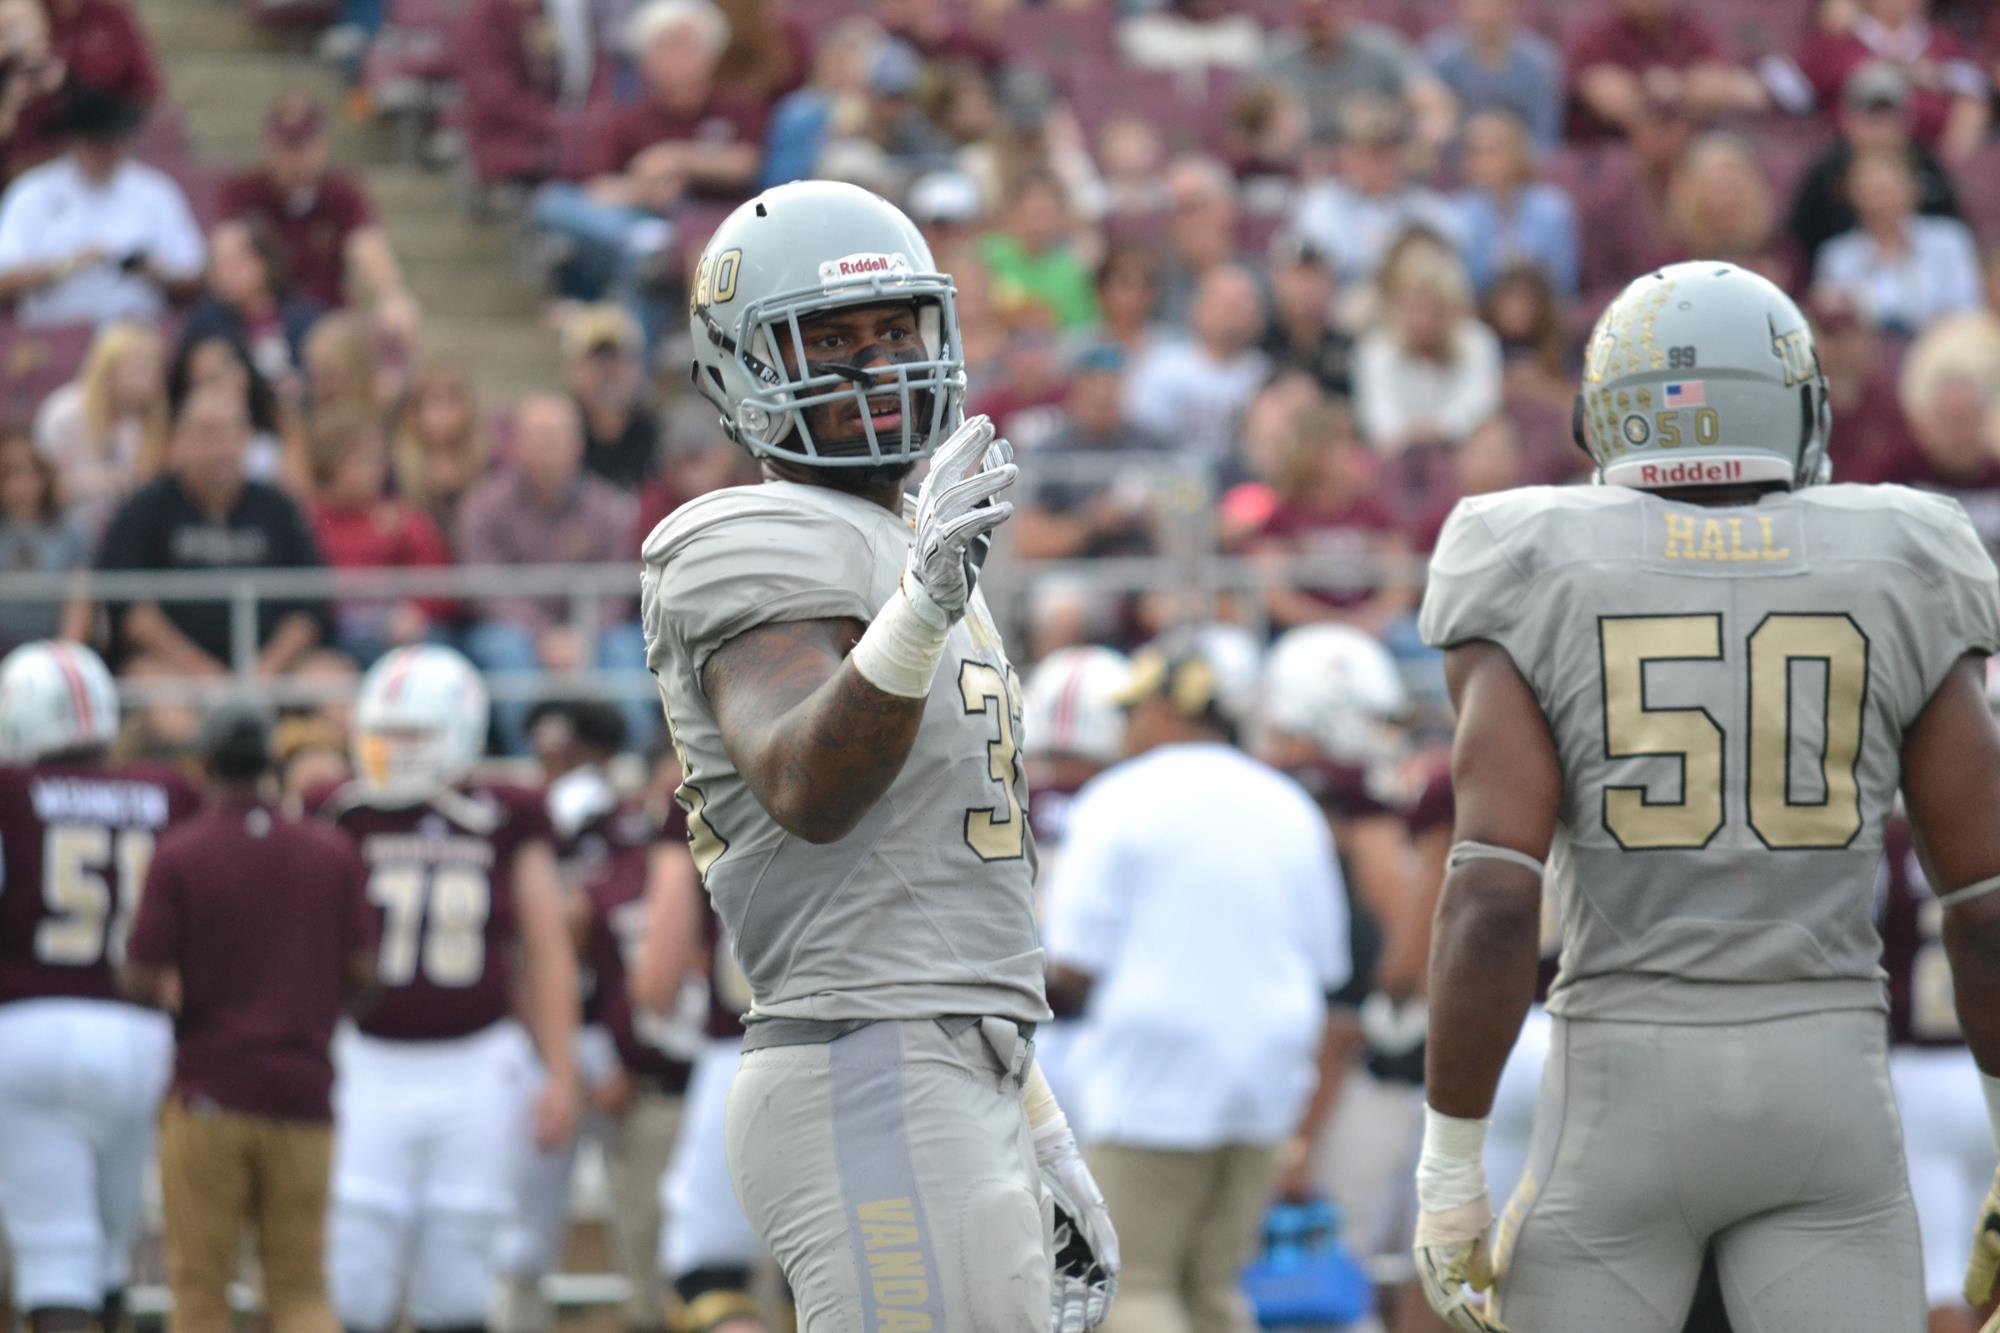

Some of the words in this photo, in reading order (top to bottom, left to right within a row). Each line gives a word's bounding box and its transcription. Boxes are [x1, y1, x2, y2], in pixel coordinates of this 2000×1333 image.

[840, 257, 888, 275] Riddell
[1668, 346, 1696, 369] 99
[1642, 461, 1742, 483] Riddell
[1664, 514, 1790, 560] HALL
[1598, 612, 1869, 852] 50
[366, 862, 491, 987] 78
[856, 1196, 935, 1333] VANDA
